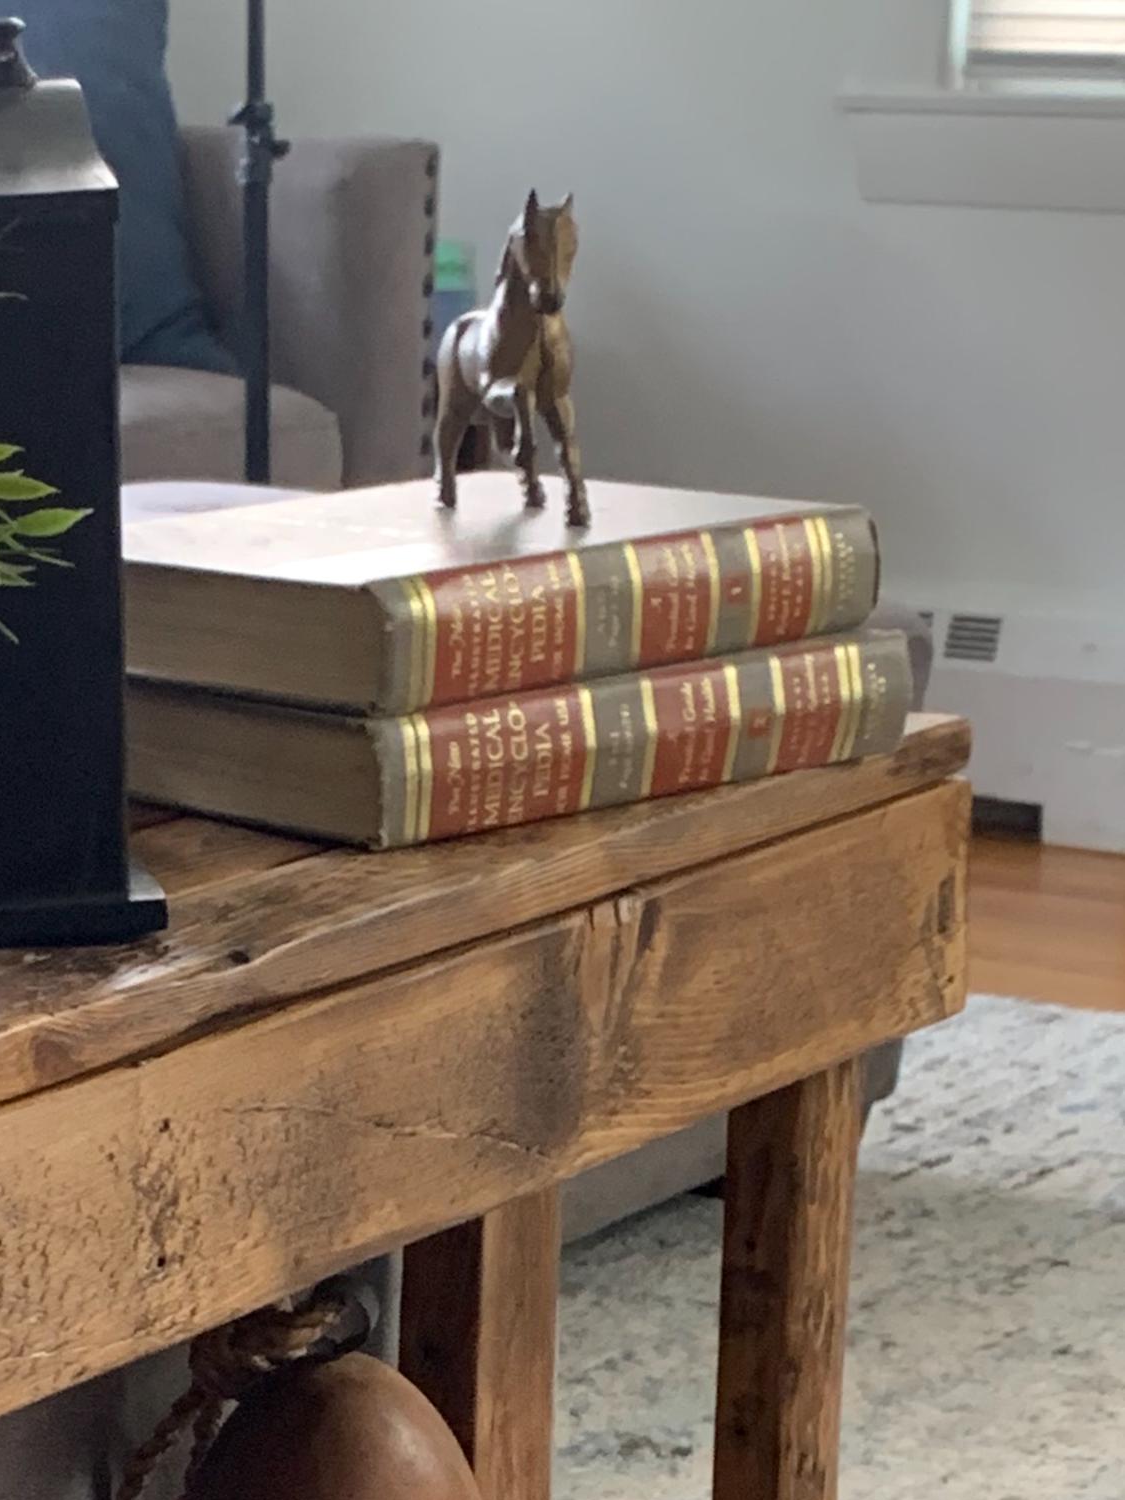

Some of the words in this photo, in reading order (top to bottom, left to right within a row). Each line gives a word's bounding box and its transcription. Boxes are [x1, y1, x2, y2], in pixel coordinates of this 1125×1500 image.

[479, 570, 504, 691] MEDICAL
[530, 584, 548, 664] PEDIA
[481, 708, 505, 827] MEDICAL
[532, 721, 554, 798] PEDIA
